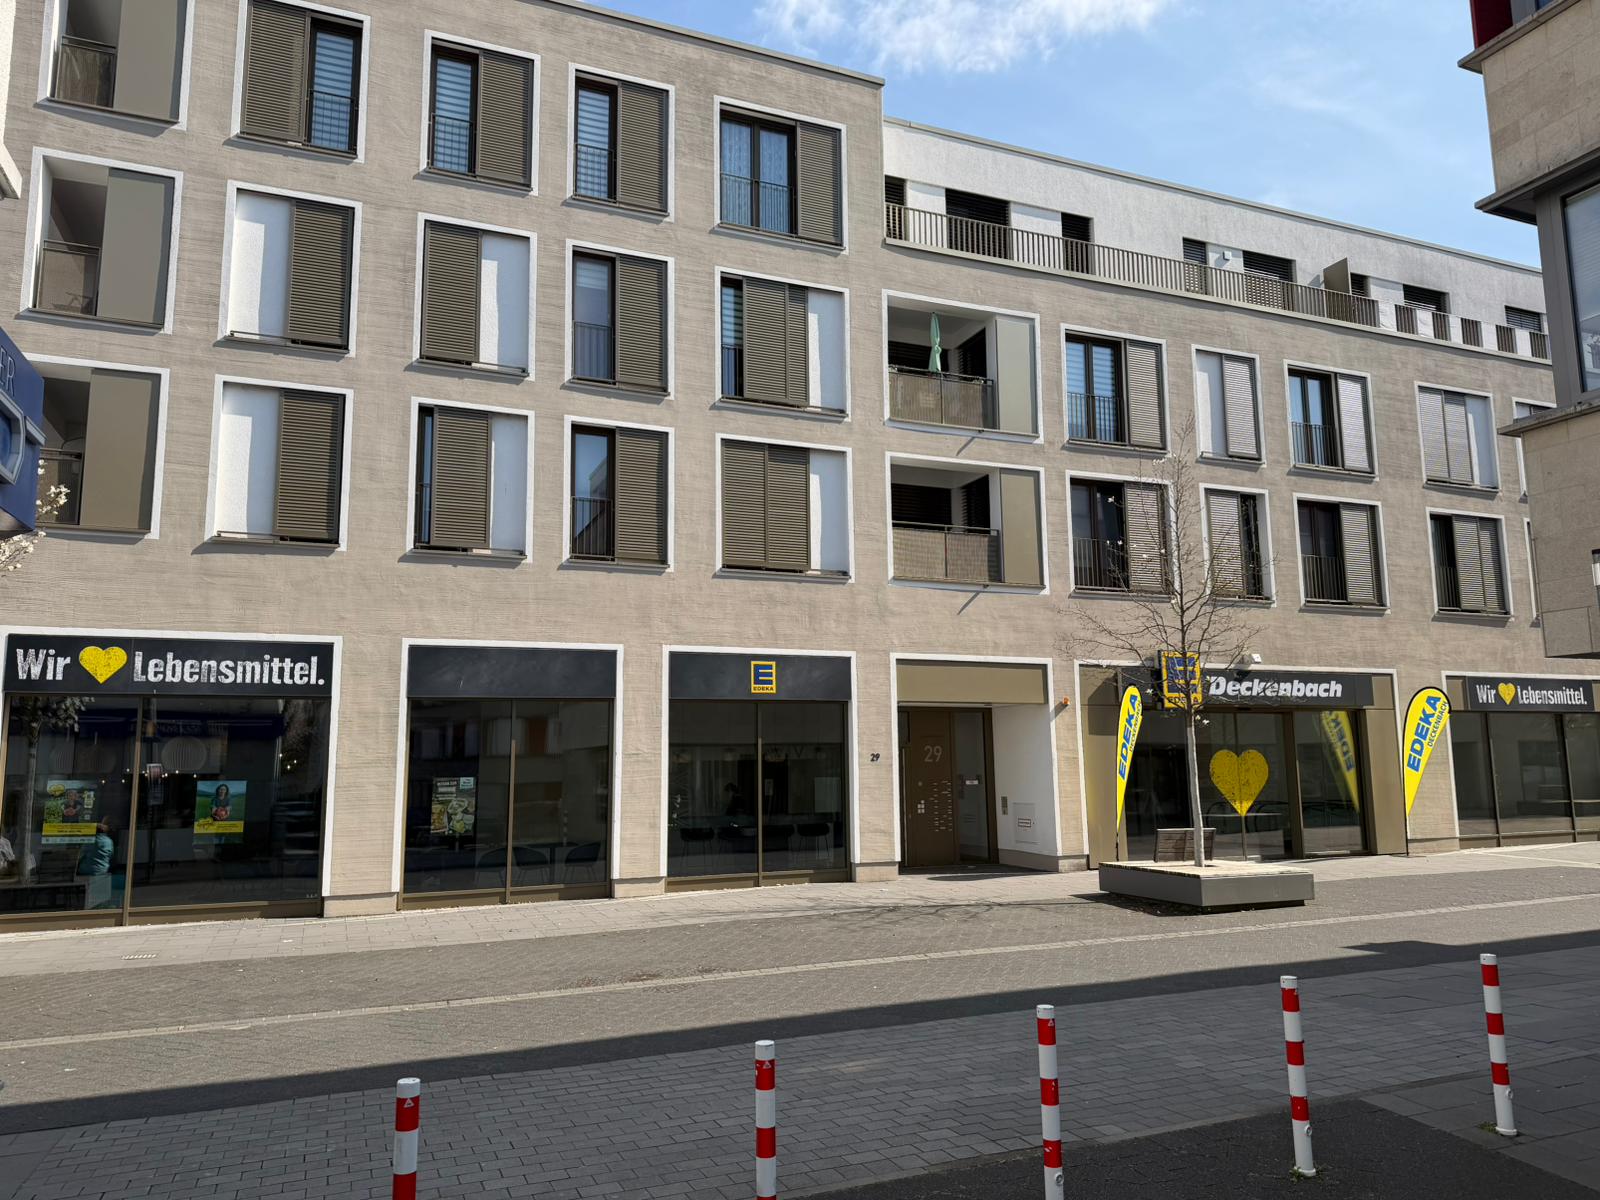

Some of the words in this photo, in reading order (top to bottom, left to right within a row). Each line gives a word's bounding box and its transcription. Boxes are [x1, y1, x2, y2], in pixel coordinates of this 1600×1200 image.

[16, 648, 71, 681] Wir
[133, 651, 325, 686] Lebensmittel.
[1209, 676, 1342, 697] Deckenbach
[1476, 684, 1496, 703] Wir
[1517, 686, 1587, 705] Lebensmittel.
[1119, 694, 1138, 780] EDEKA
[1407, 695, 1441, 772] EDEKA
[1427, 700, 1448, 747] DECKENBACH
[870, 752, 880, 762] 29
[924, 745, 942, 762] 29
